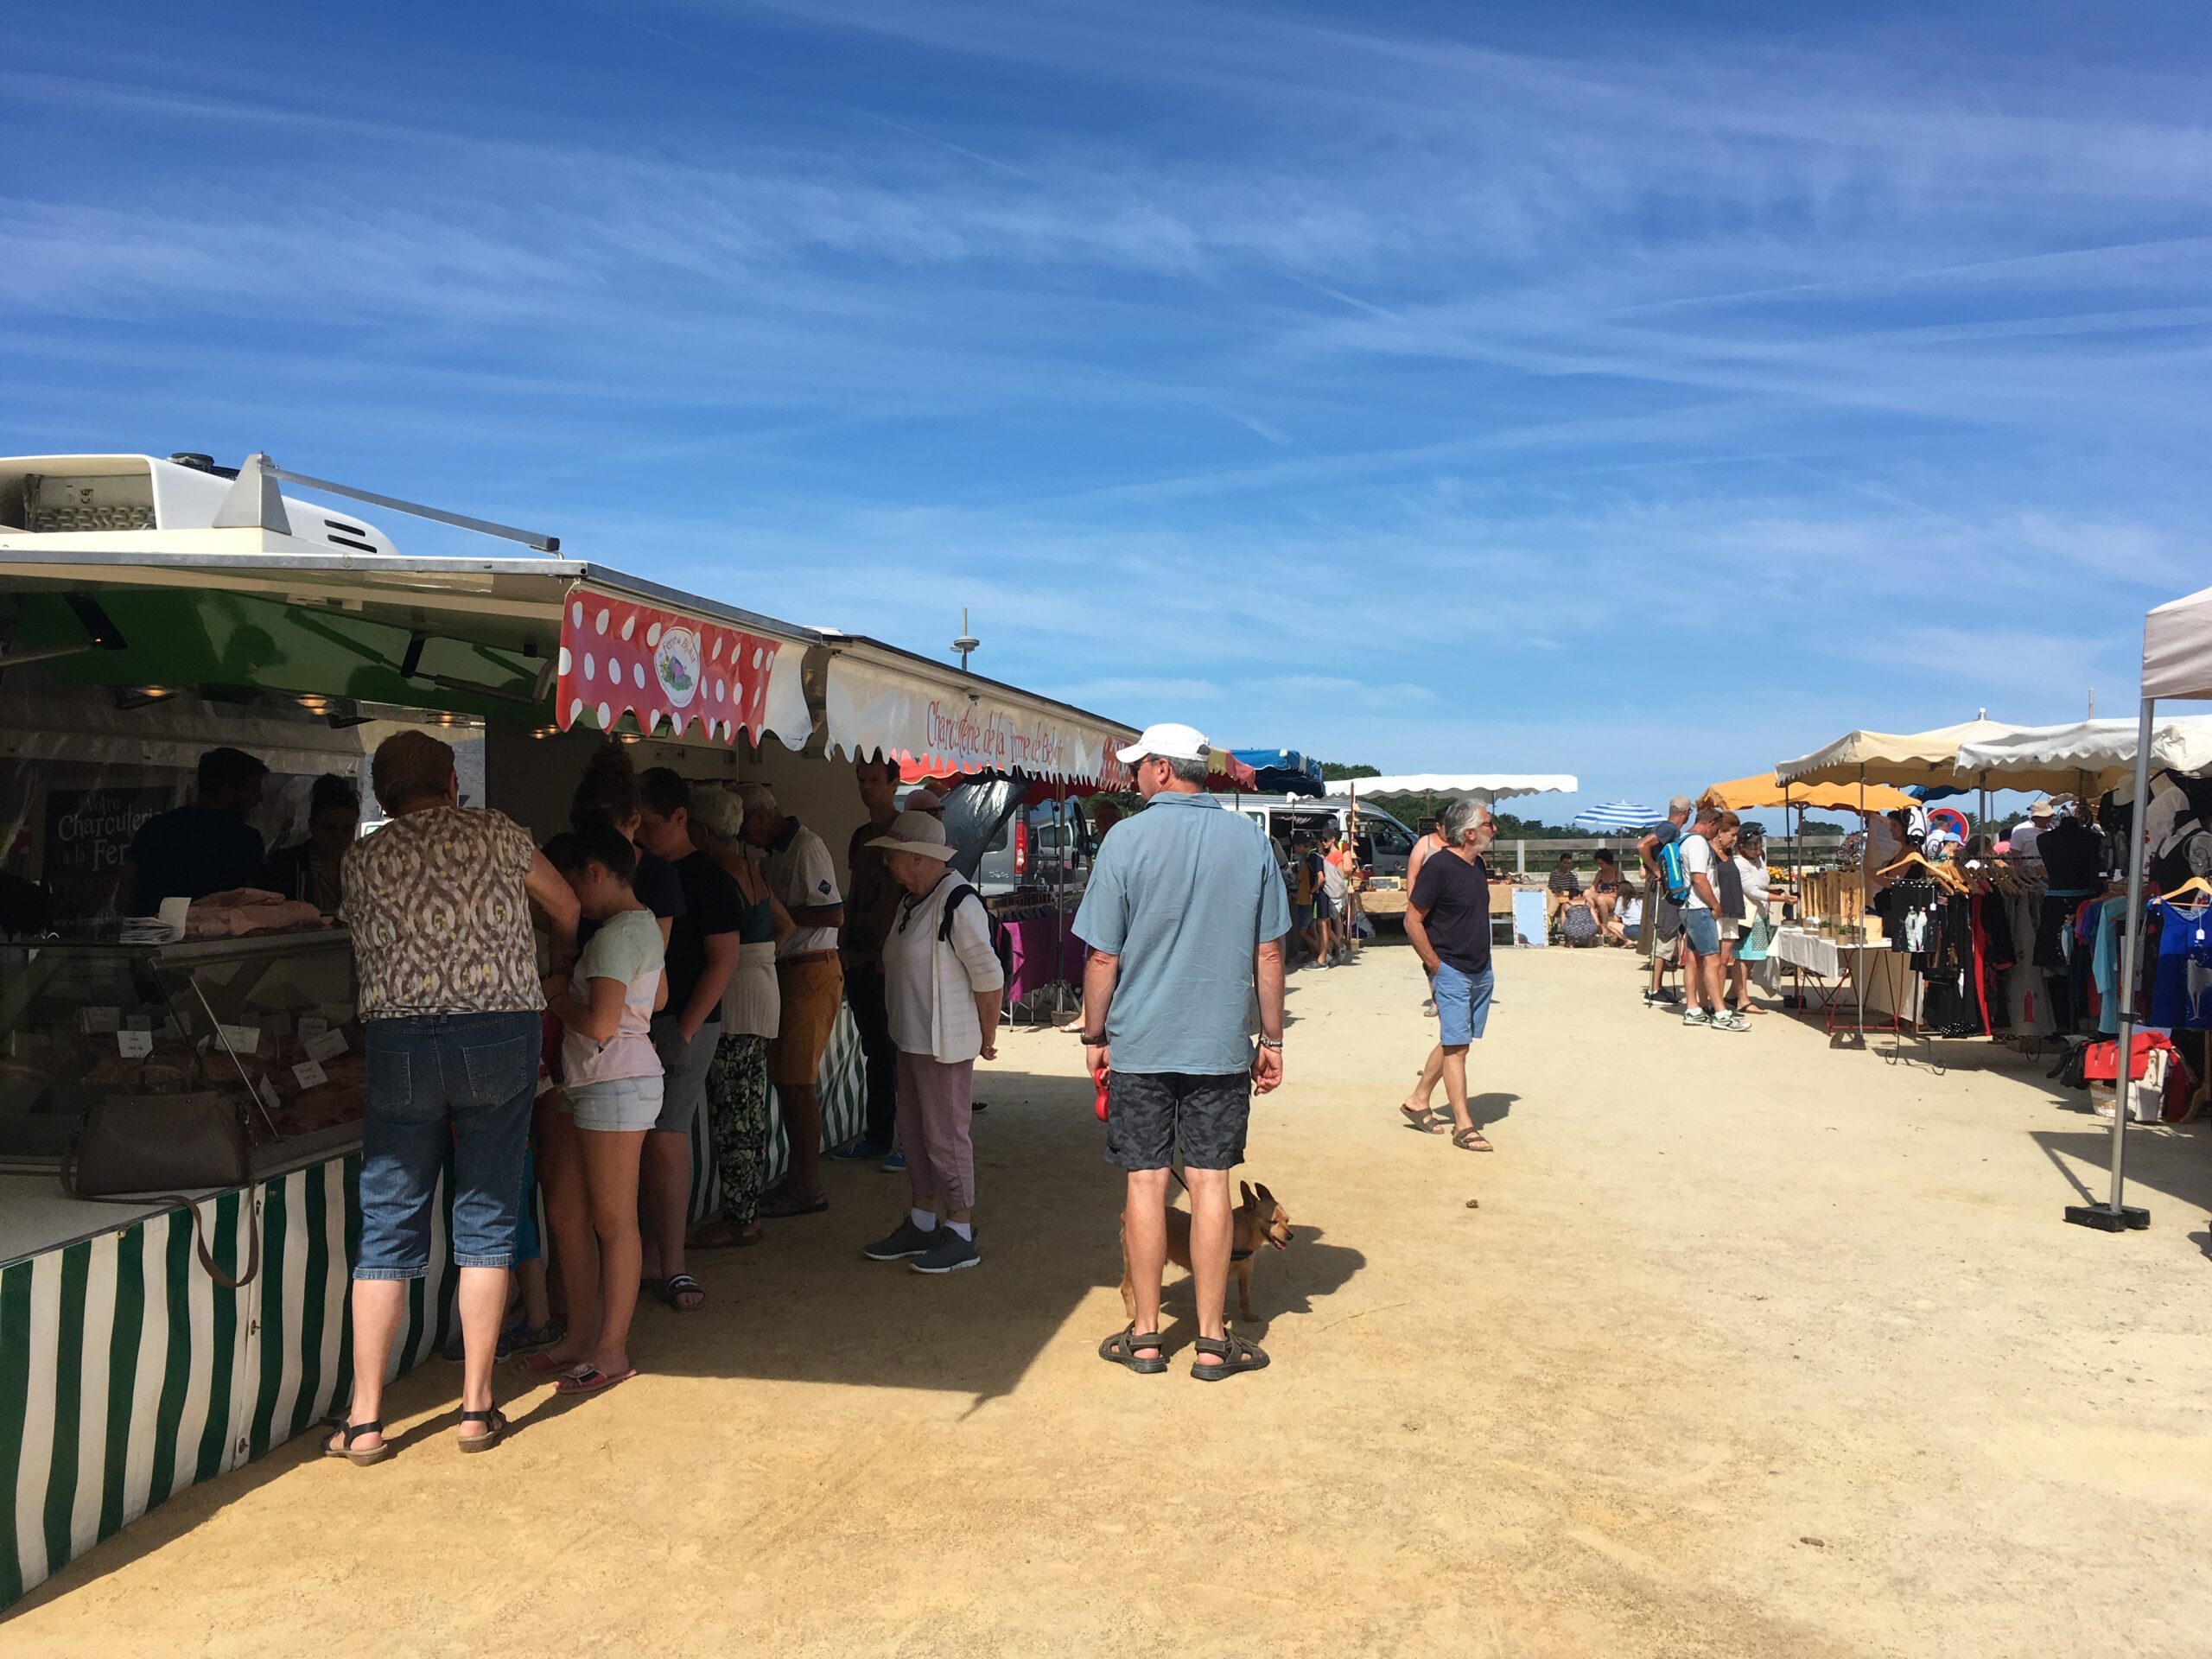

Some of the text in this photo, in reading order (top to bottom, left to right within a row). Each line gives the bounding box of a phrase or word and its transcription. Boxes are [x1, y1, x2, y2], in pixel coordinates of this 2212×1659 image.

[926, 700, 981, 758] Charcuterie
[983, 709, 995, 755] de
[995, 710, 1005, 760] la
[1032, 721, 1041, 763] de
[92, 839, 130, 871] Fer
